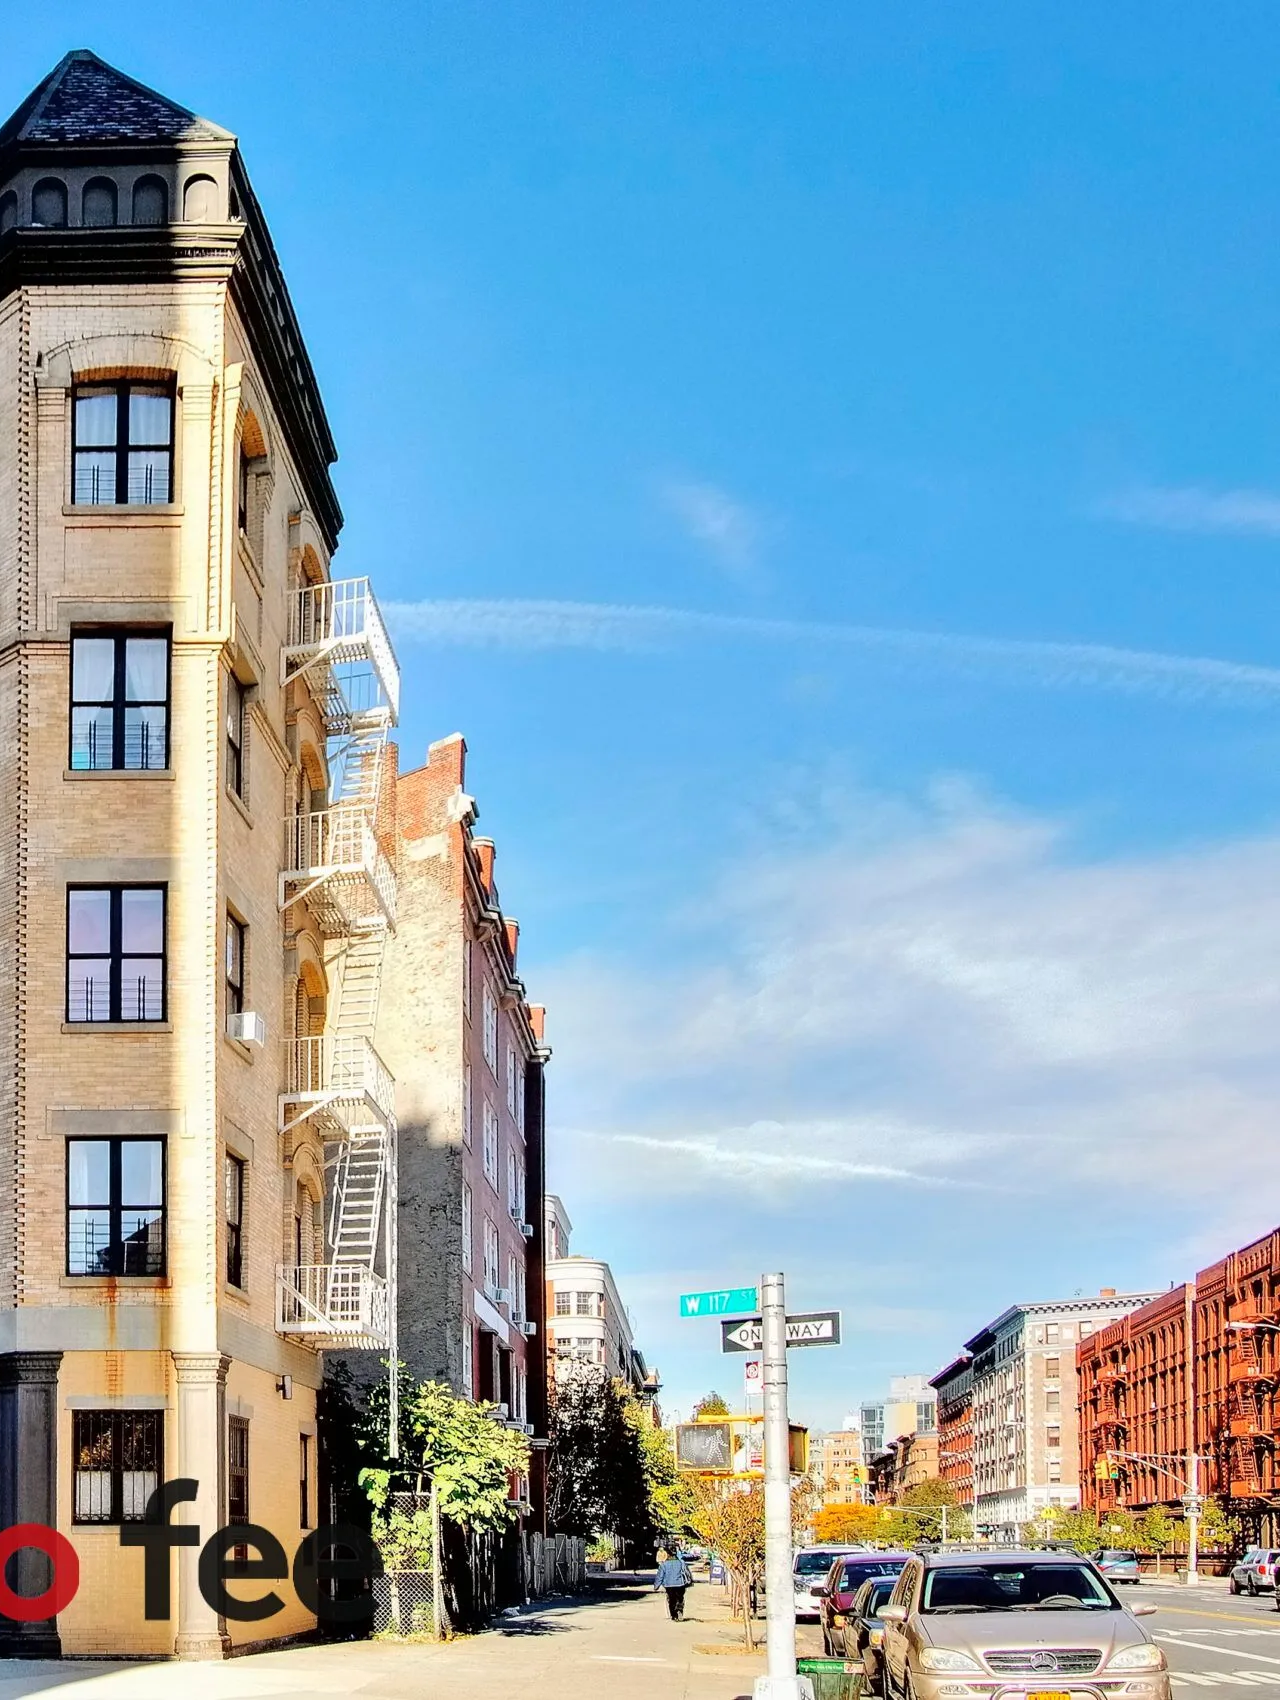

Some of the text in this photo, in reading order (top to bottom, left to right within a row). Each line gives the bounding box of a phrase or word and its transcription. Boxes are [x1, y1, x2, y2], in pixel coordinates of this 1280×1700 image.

[685, 1290, 754, 1315] W 117 ST
[739, 1323, 824, 1342] ON WAY
